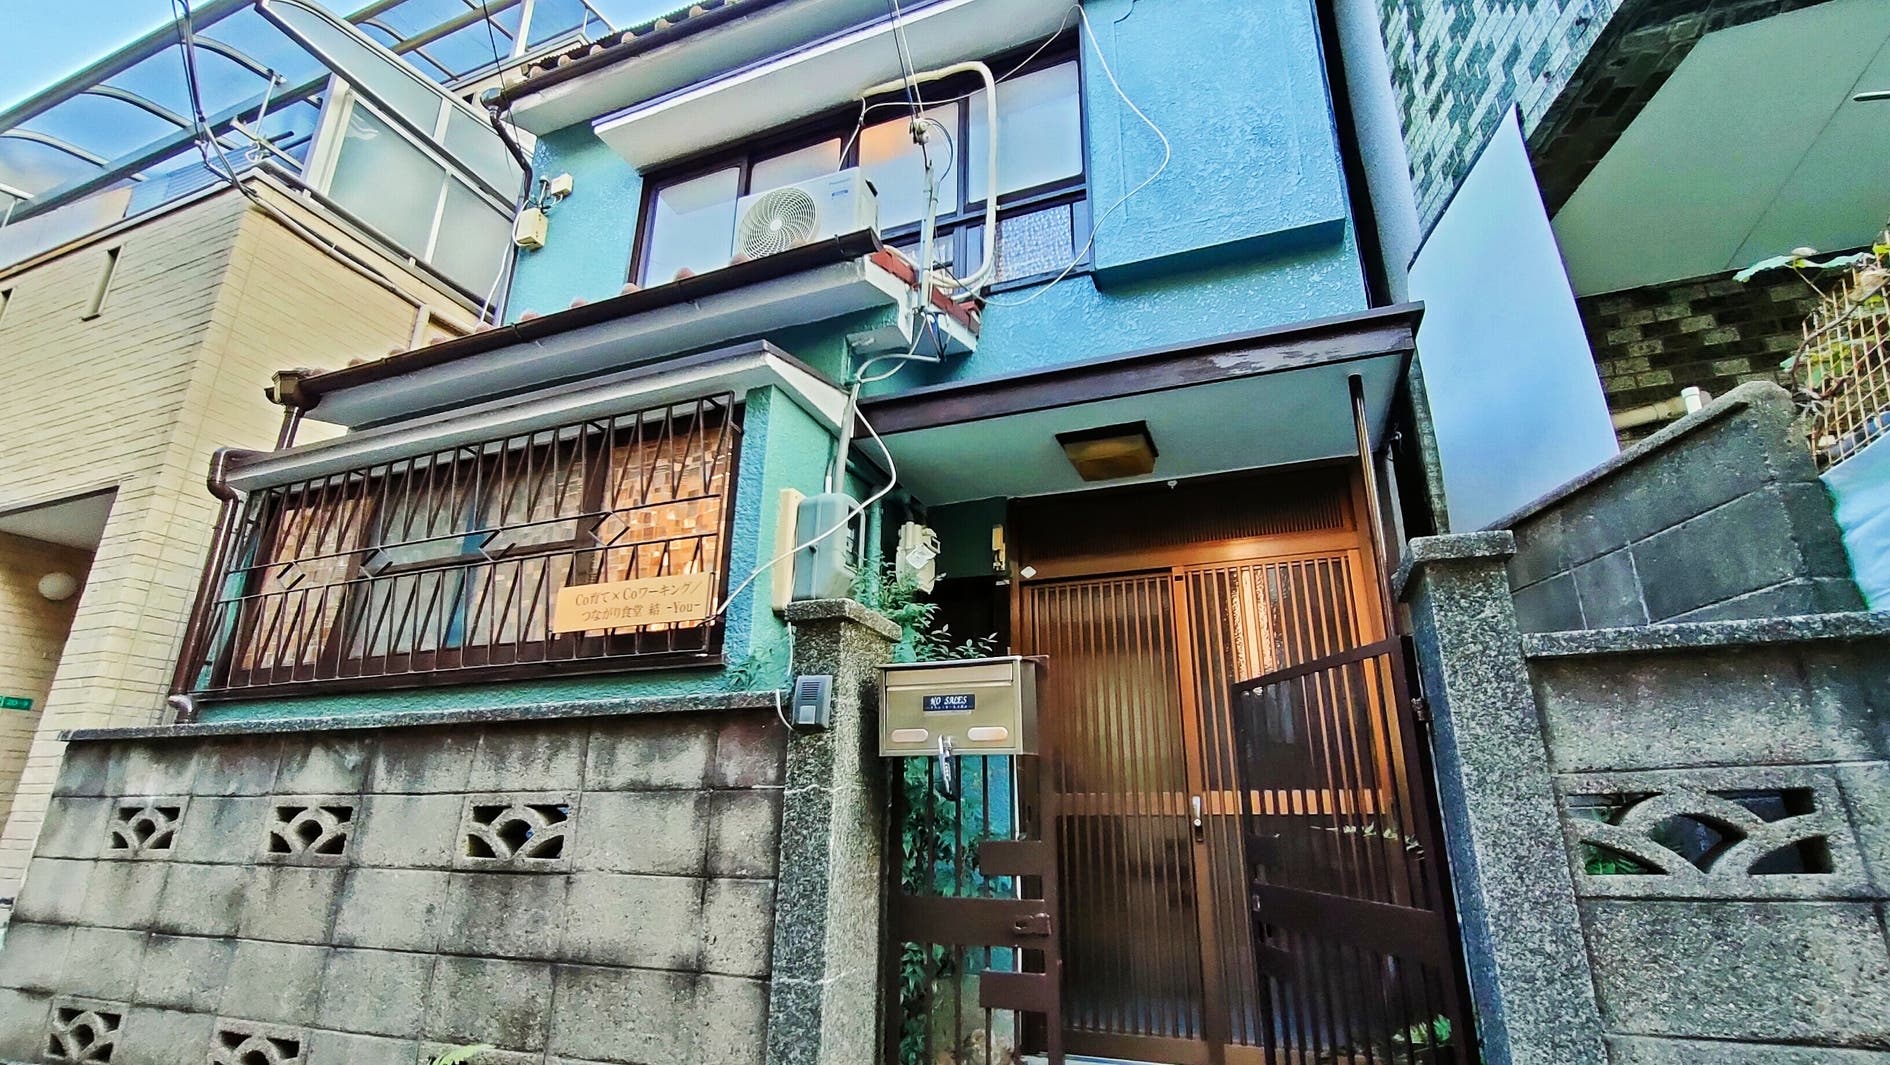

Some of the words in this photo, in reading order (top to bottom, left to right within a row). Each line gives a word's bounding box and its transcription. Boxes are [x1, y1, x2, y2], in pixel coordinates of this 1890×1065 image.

[581, 604, 643, 622] つながり食堂
[930, 696, 942, 707] NO
[944, 695, 968, 705] SALES
